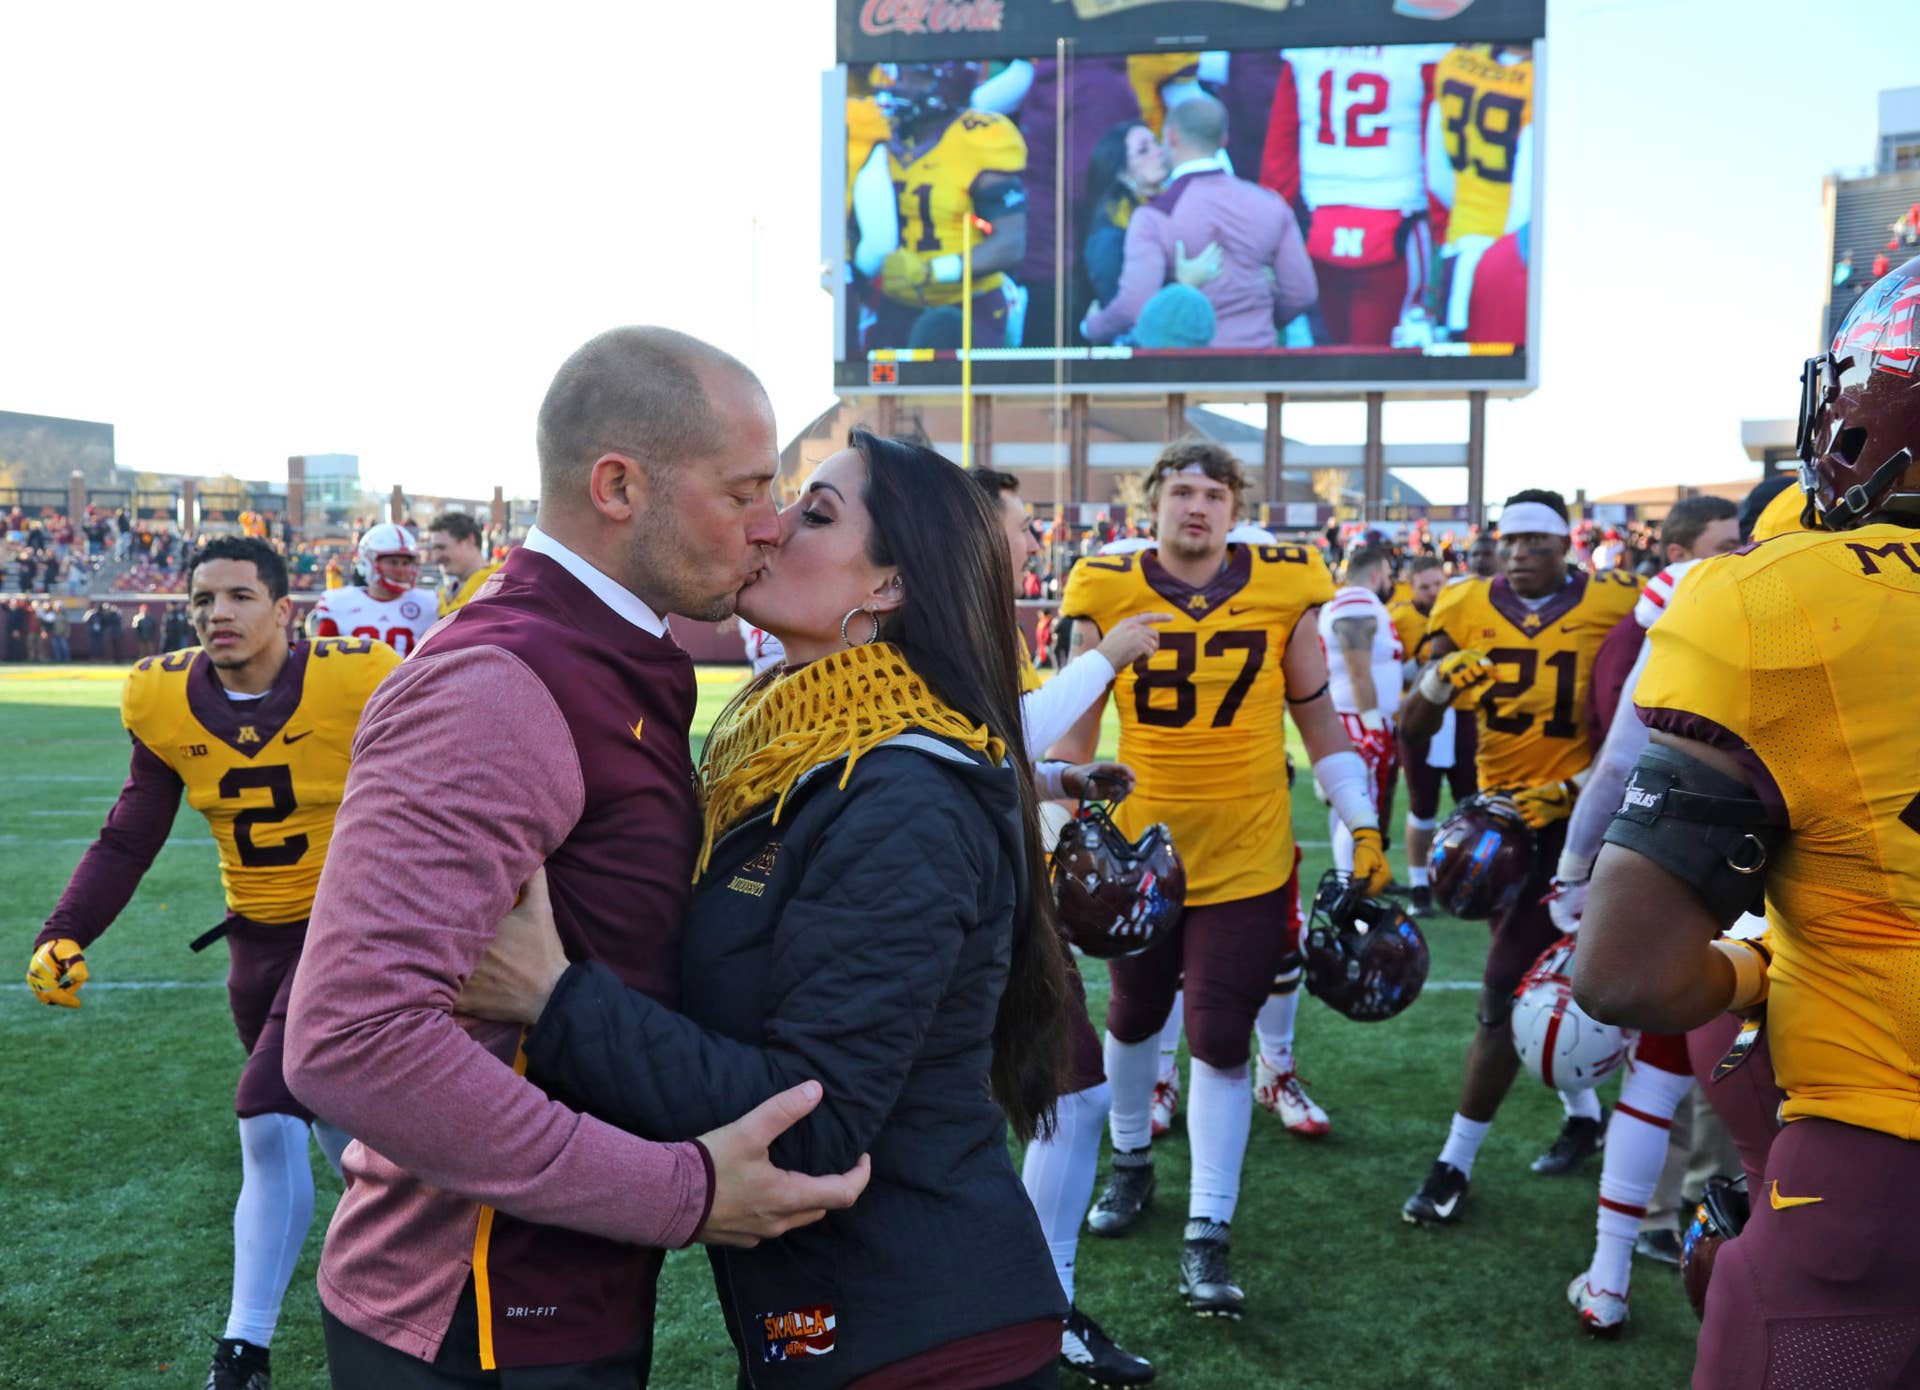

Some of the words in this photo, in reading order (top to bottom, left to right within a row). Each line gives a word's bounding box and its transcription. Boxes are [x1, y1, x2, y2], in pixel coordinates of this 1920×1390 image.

[1317, 70, 1389, 147] 12
[1442, 78, 1527, 184] 39
[1332, 226, 1365, 257] N
[1845, 543, 1920, 576] M
[1133, 630, 1268, 729] 87
[1480, 648, 1578, 739] 21
[237, 726, 261, 744] M
[218, 764, 310, 868] 2
[506, 1306, 558, 1317] DRI-FIT
[764, 1310, 828, 1341] SKALLA
